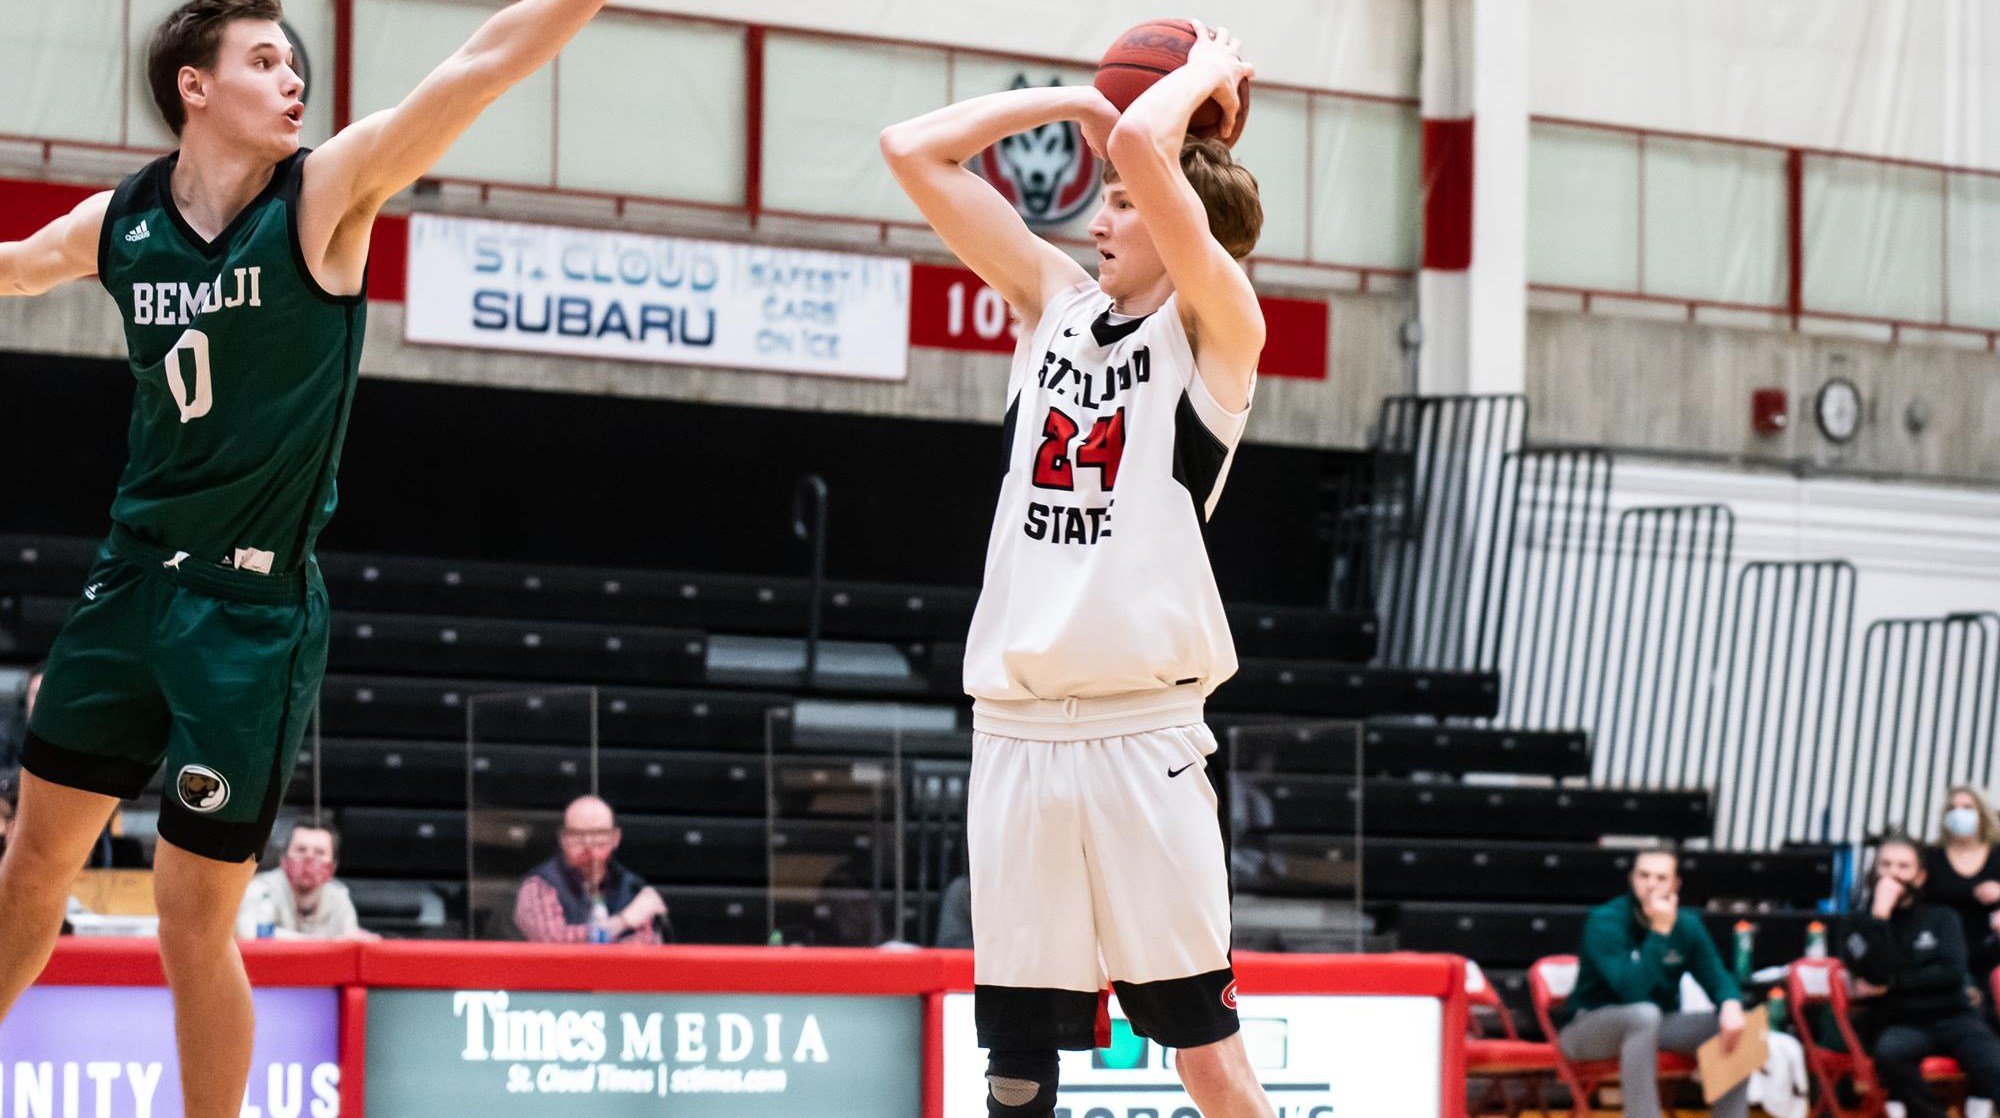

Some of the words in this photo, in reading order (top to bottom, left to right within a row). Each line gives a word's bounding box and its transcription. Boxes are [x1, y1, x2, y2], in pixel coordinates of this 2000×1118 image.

[474, 237, 546, 282] ST.
[560, 241, 718, 292] CLOUD
[132, 266, 261, 325] BEMDJI
[472, 289, 716, 347] SUBARU
[947, 281, 1023, 339] 10
[757, 328, 793, 354] ON
[164, 329, 212, 423] 0
[1032, 406, 1126, 491] 24
[453, 990, 606, 1062] Times
[619, 1012, 829, 1063] MEDIA
[0, 1061, 162, 1118] NITY
[240, 1062, 341, 1118] LUS
[536, 1063, 595, 1093] Cloud
[597, 1064, 654, 1093] Times
